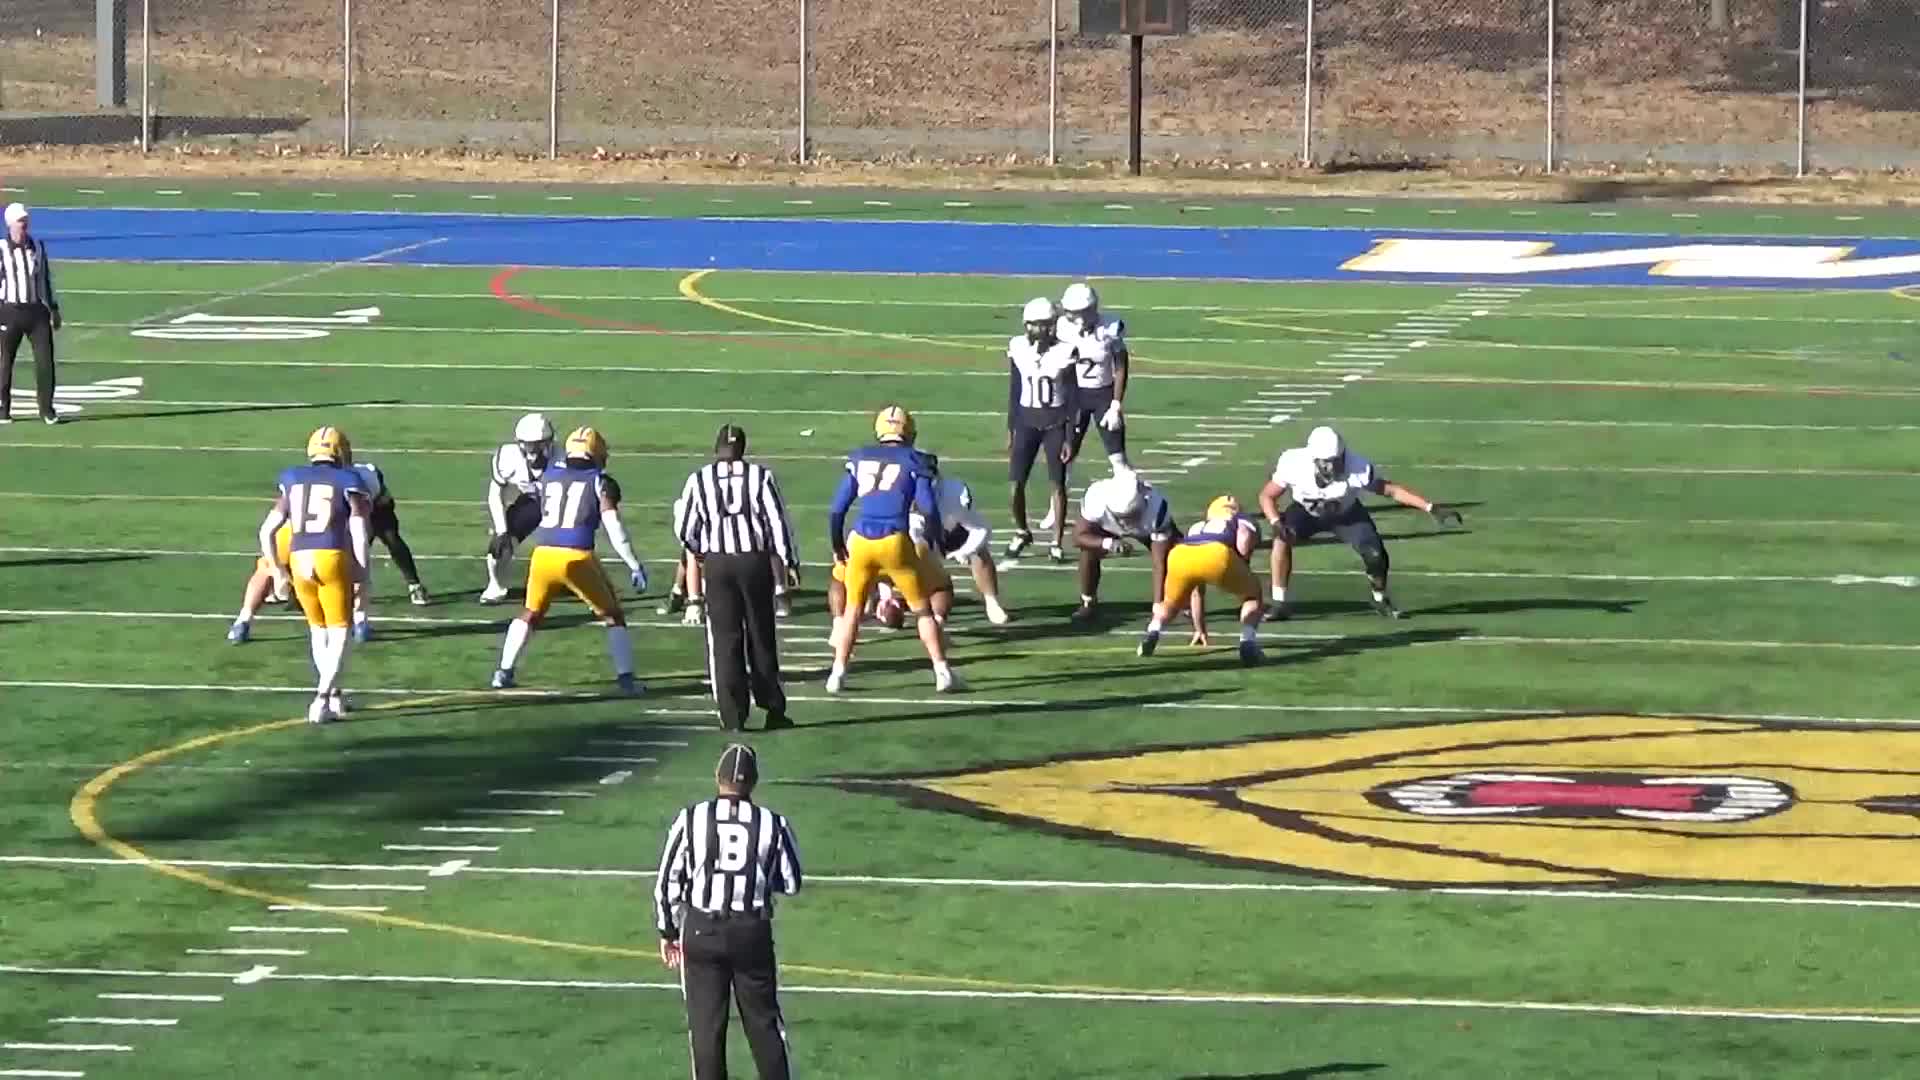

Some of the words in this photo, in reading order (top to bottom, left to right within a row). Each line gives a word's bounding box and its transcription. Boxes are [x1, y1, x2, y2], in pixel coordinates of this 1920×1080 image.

[1027, 375, 1054, 406] 10
[1077, 357, 1098, 380] 2
[288, 484, 334, 533] 15
[540, 481, 587, 528] 31
[716, 474, 748, 516] U
[715, 823, 749, 872] B
